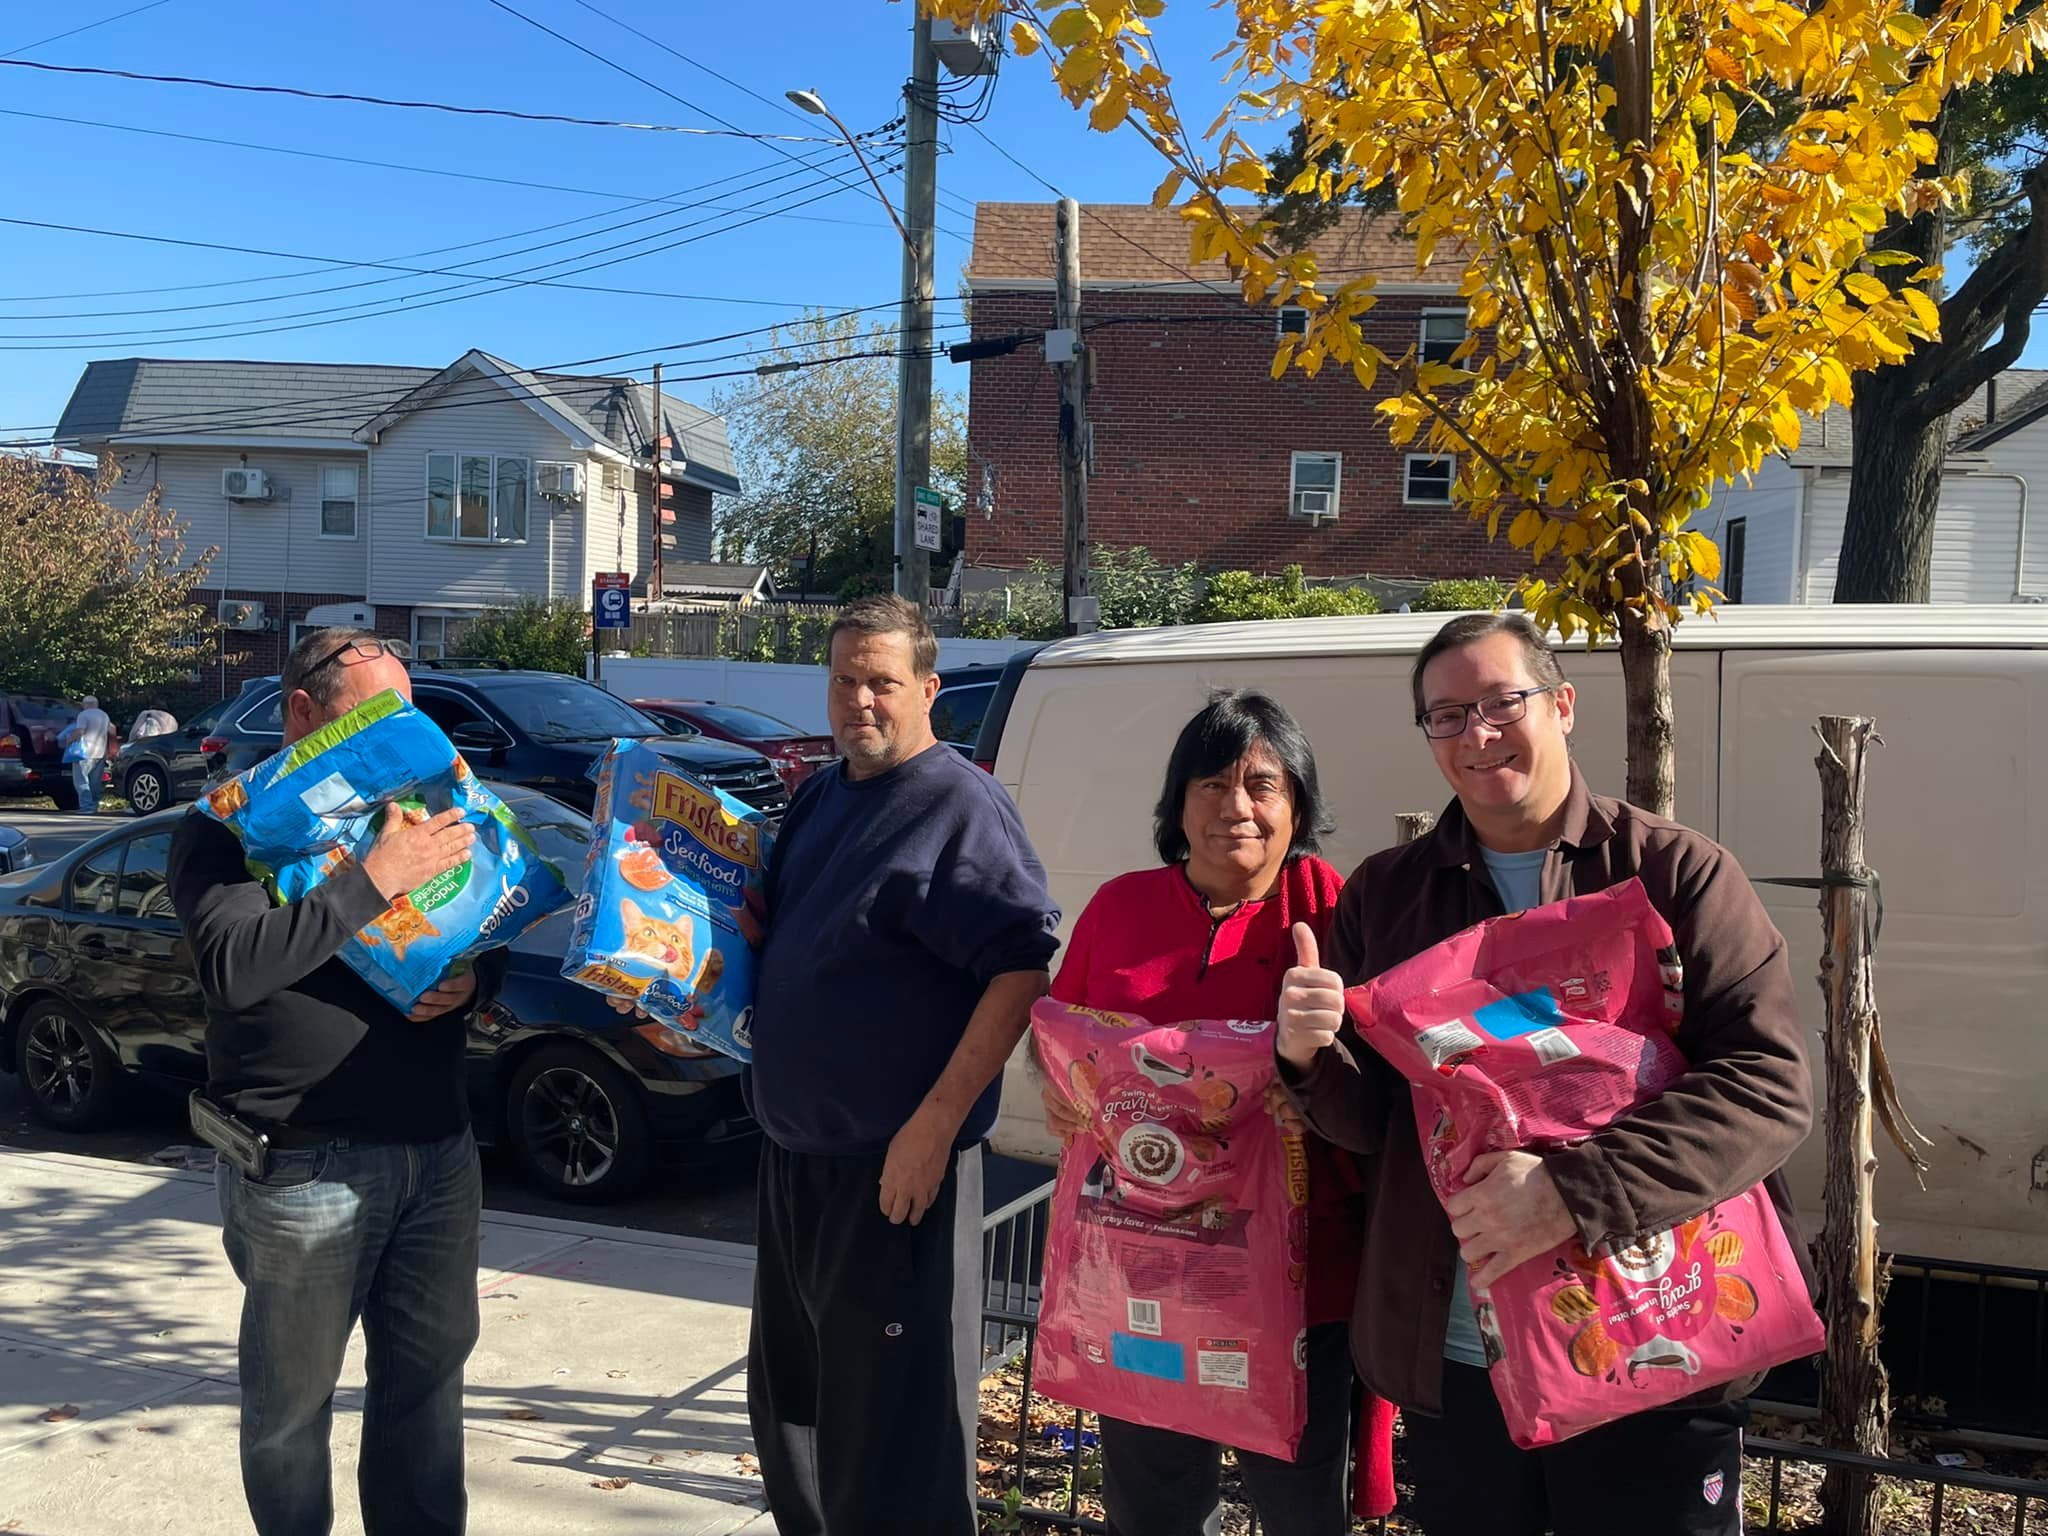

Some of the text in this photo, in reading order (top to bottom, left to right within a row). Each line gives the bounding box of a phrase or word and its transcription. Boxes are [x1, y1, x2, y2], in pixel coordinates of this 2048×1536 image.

[920, 534, 936, 546] LANE
[664, 782, 751, 857] Friskies
[664, 830, 741, 887] Seafood
[413, 865, 464, 902] Complete
[423, 880, 460, 912] Indoor
[479, 874, 529, 940] 9Lives
[584, 967, 642, 996] Friskies
[1102, 1097, 1170, 1122] gravy
[1635, 1262, 1701, 1310] gravy
[1648, 1297, 1660, 1307] in
